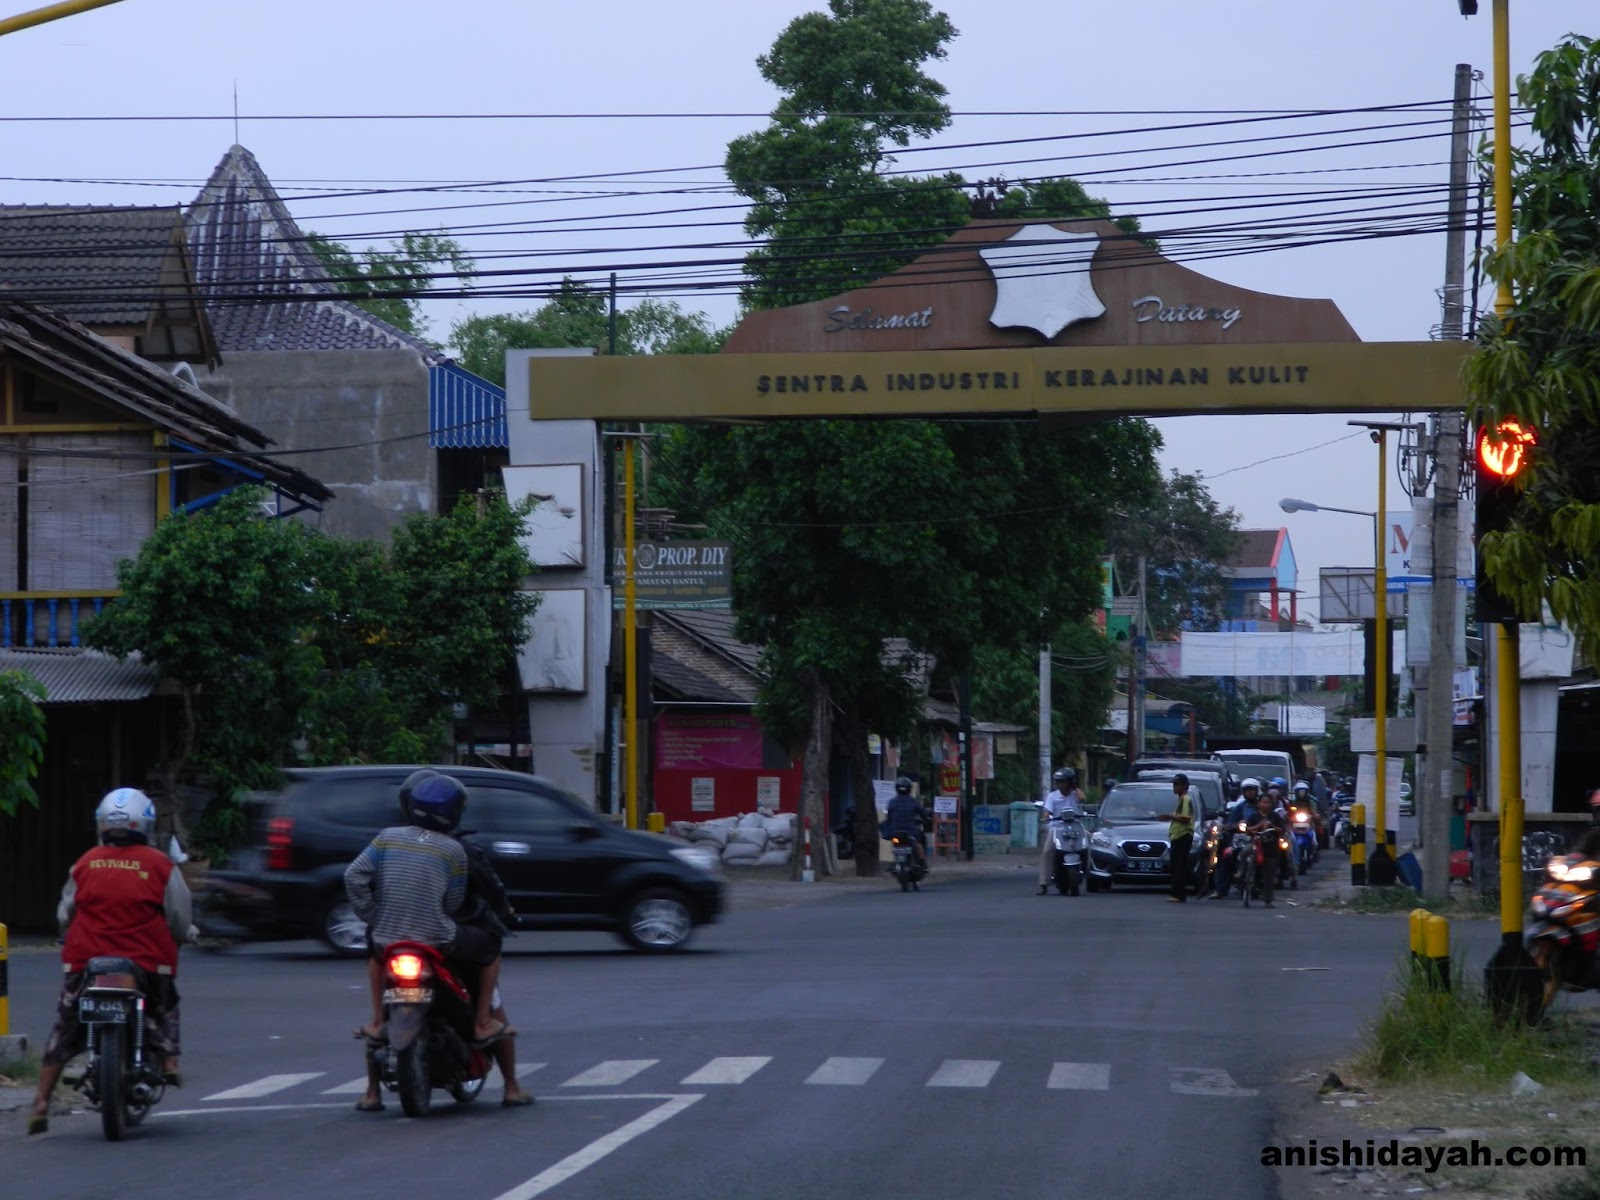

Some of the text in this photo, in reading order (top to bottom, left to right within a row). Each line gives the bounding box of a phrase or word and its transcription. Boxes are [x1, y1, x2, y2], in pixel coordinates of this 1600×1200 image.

[823, 295, 1242, 332] Selamat Datang
[756, 365, 1309, 393] SENTRA INDUSTRI KERAJINAN KULIT
[657, 547, 698, 565] PROP.
[701, 546, 729, 565] DIY
[89, 858, 141, 870] REVIVALIS
[82, 999, 95, 1011] AB
